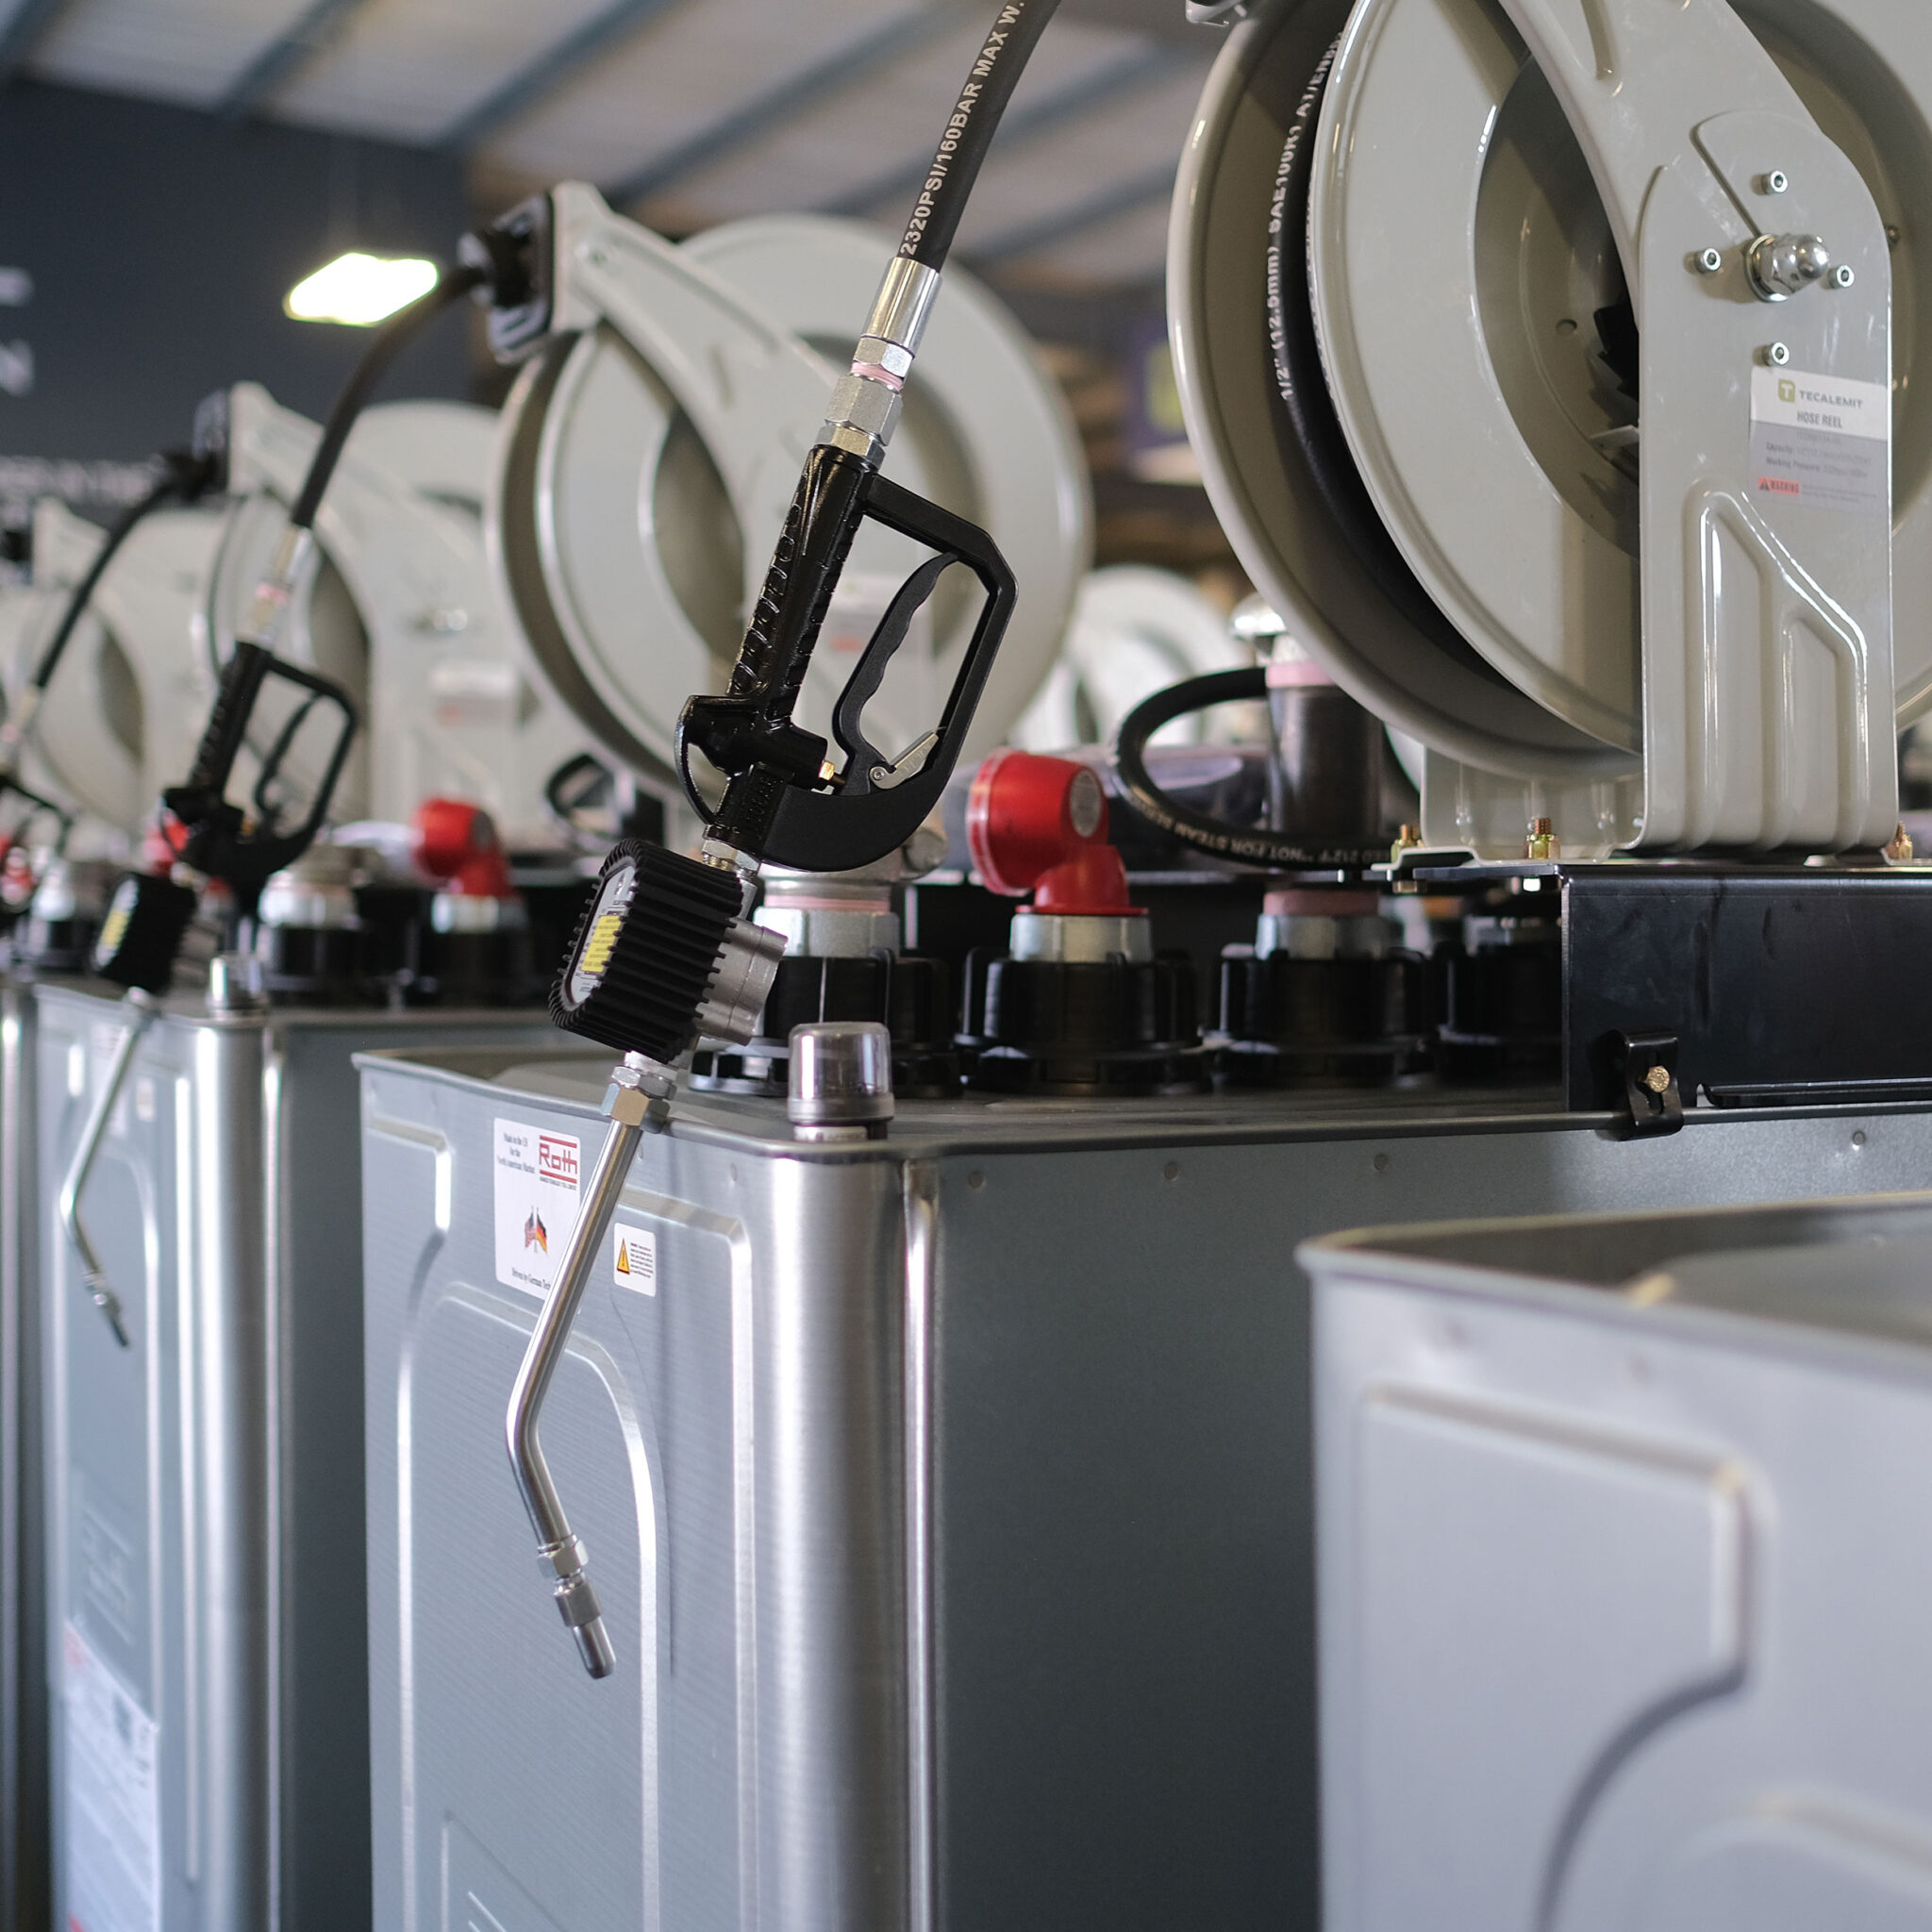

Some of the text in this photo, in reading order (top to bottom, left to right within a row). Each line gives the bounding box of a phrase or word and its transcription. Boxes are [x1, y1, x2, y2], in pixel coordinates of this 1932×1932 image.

[900, 82, 983, 257] 2320PSI/160BAR
[972, 30, 1008, 77] MAX
[1799, 390, 1863, 408] TECALEMIT
[1797, 410, 1842, 429] HOSE REEL
[539, 1142, 577, 1174] Roth
